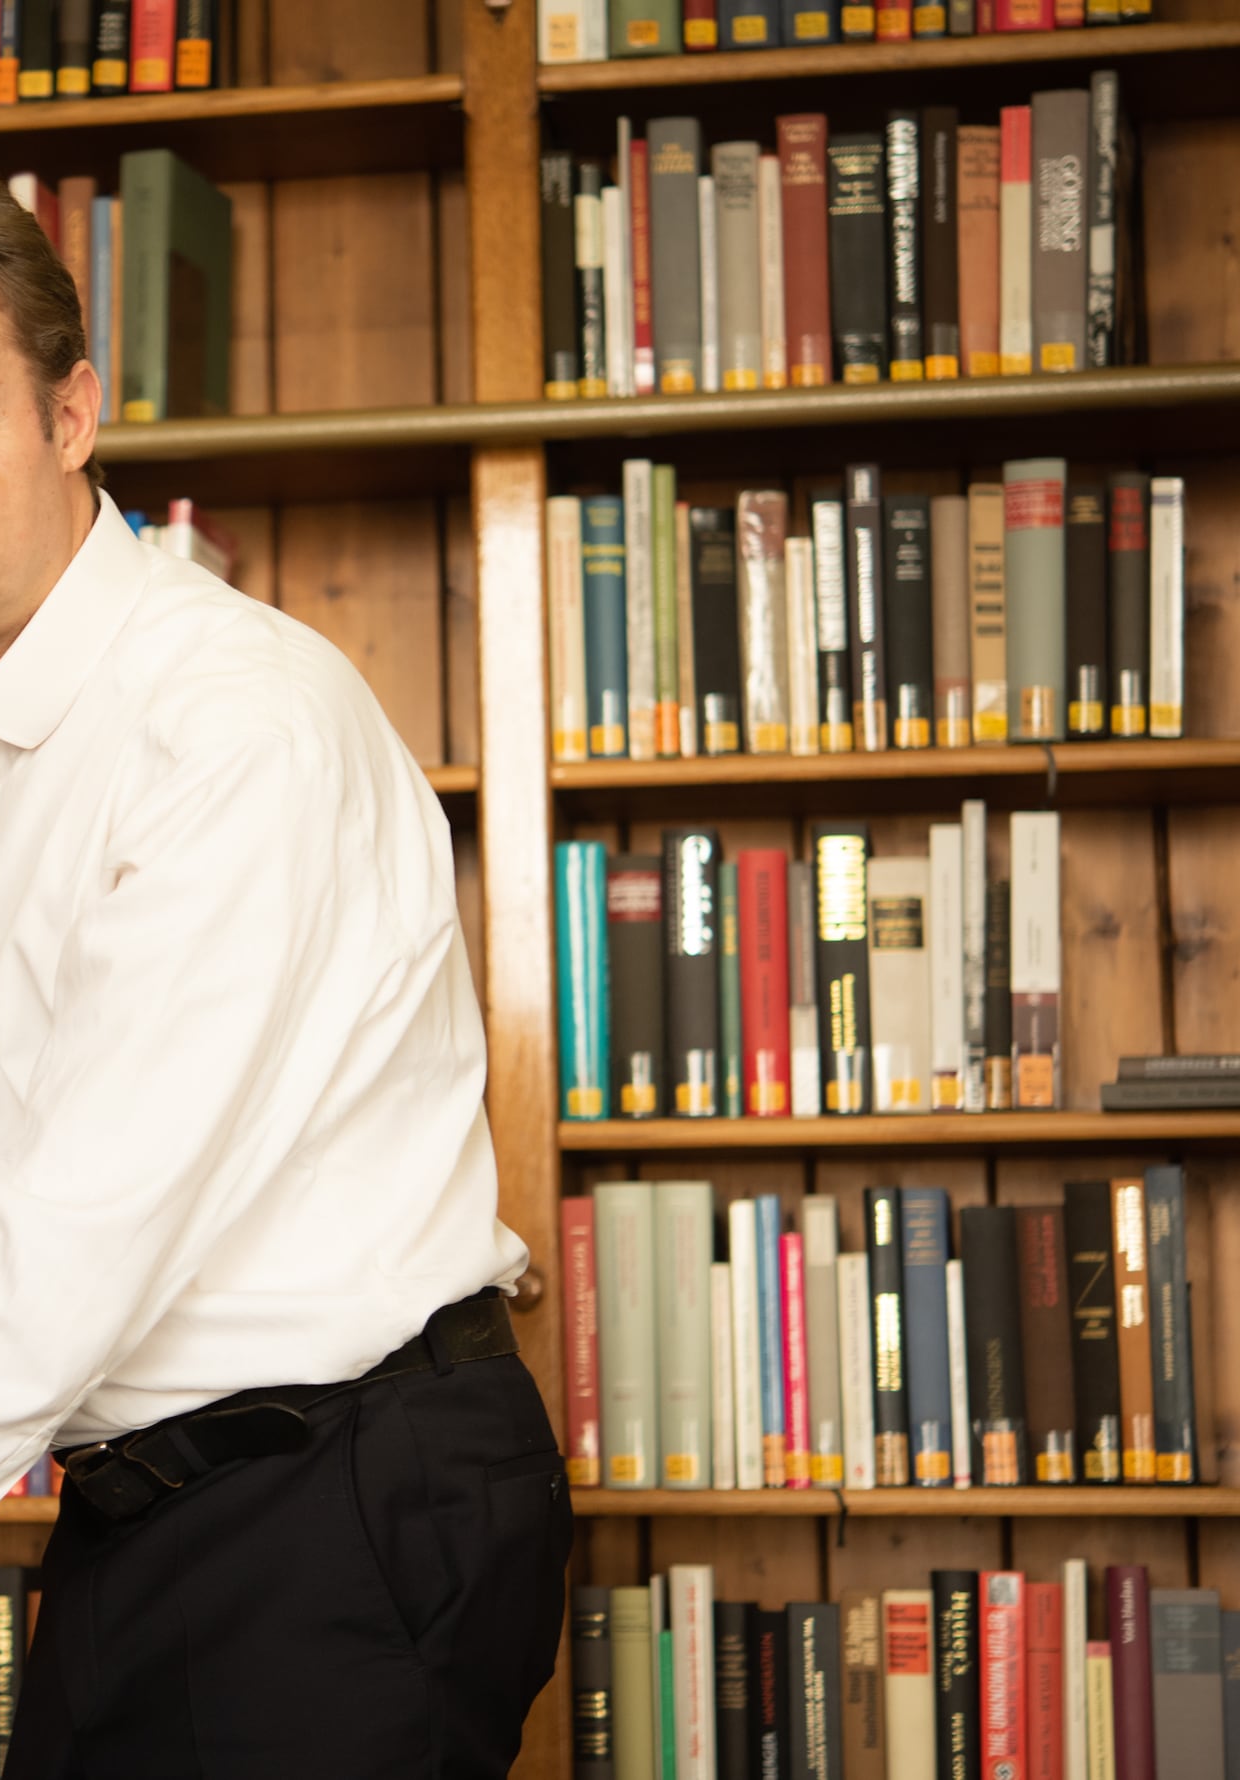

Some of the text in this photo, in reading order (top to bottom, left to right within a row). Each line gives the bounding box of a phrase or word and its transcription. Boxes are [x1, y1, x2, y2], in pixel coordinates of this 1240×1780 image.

[951, 1590, 972, 1676] Hitler's
[988, 1611, 1008, 1756] THE UNKNOWN HITLER
